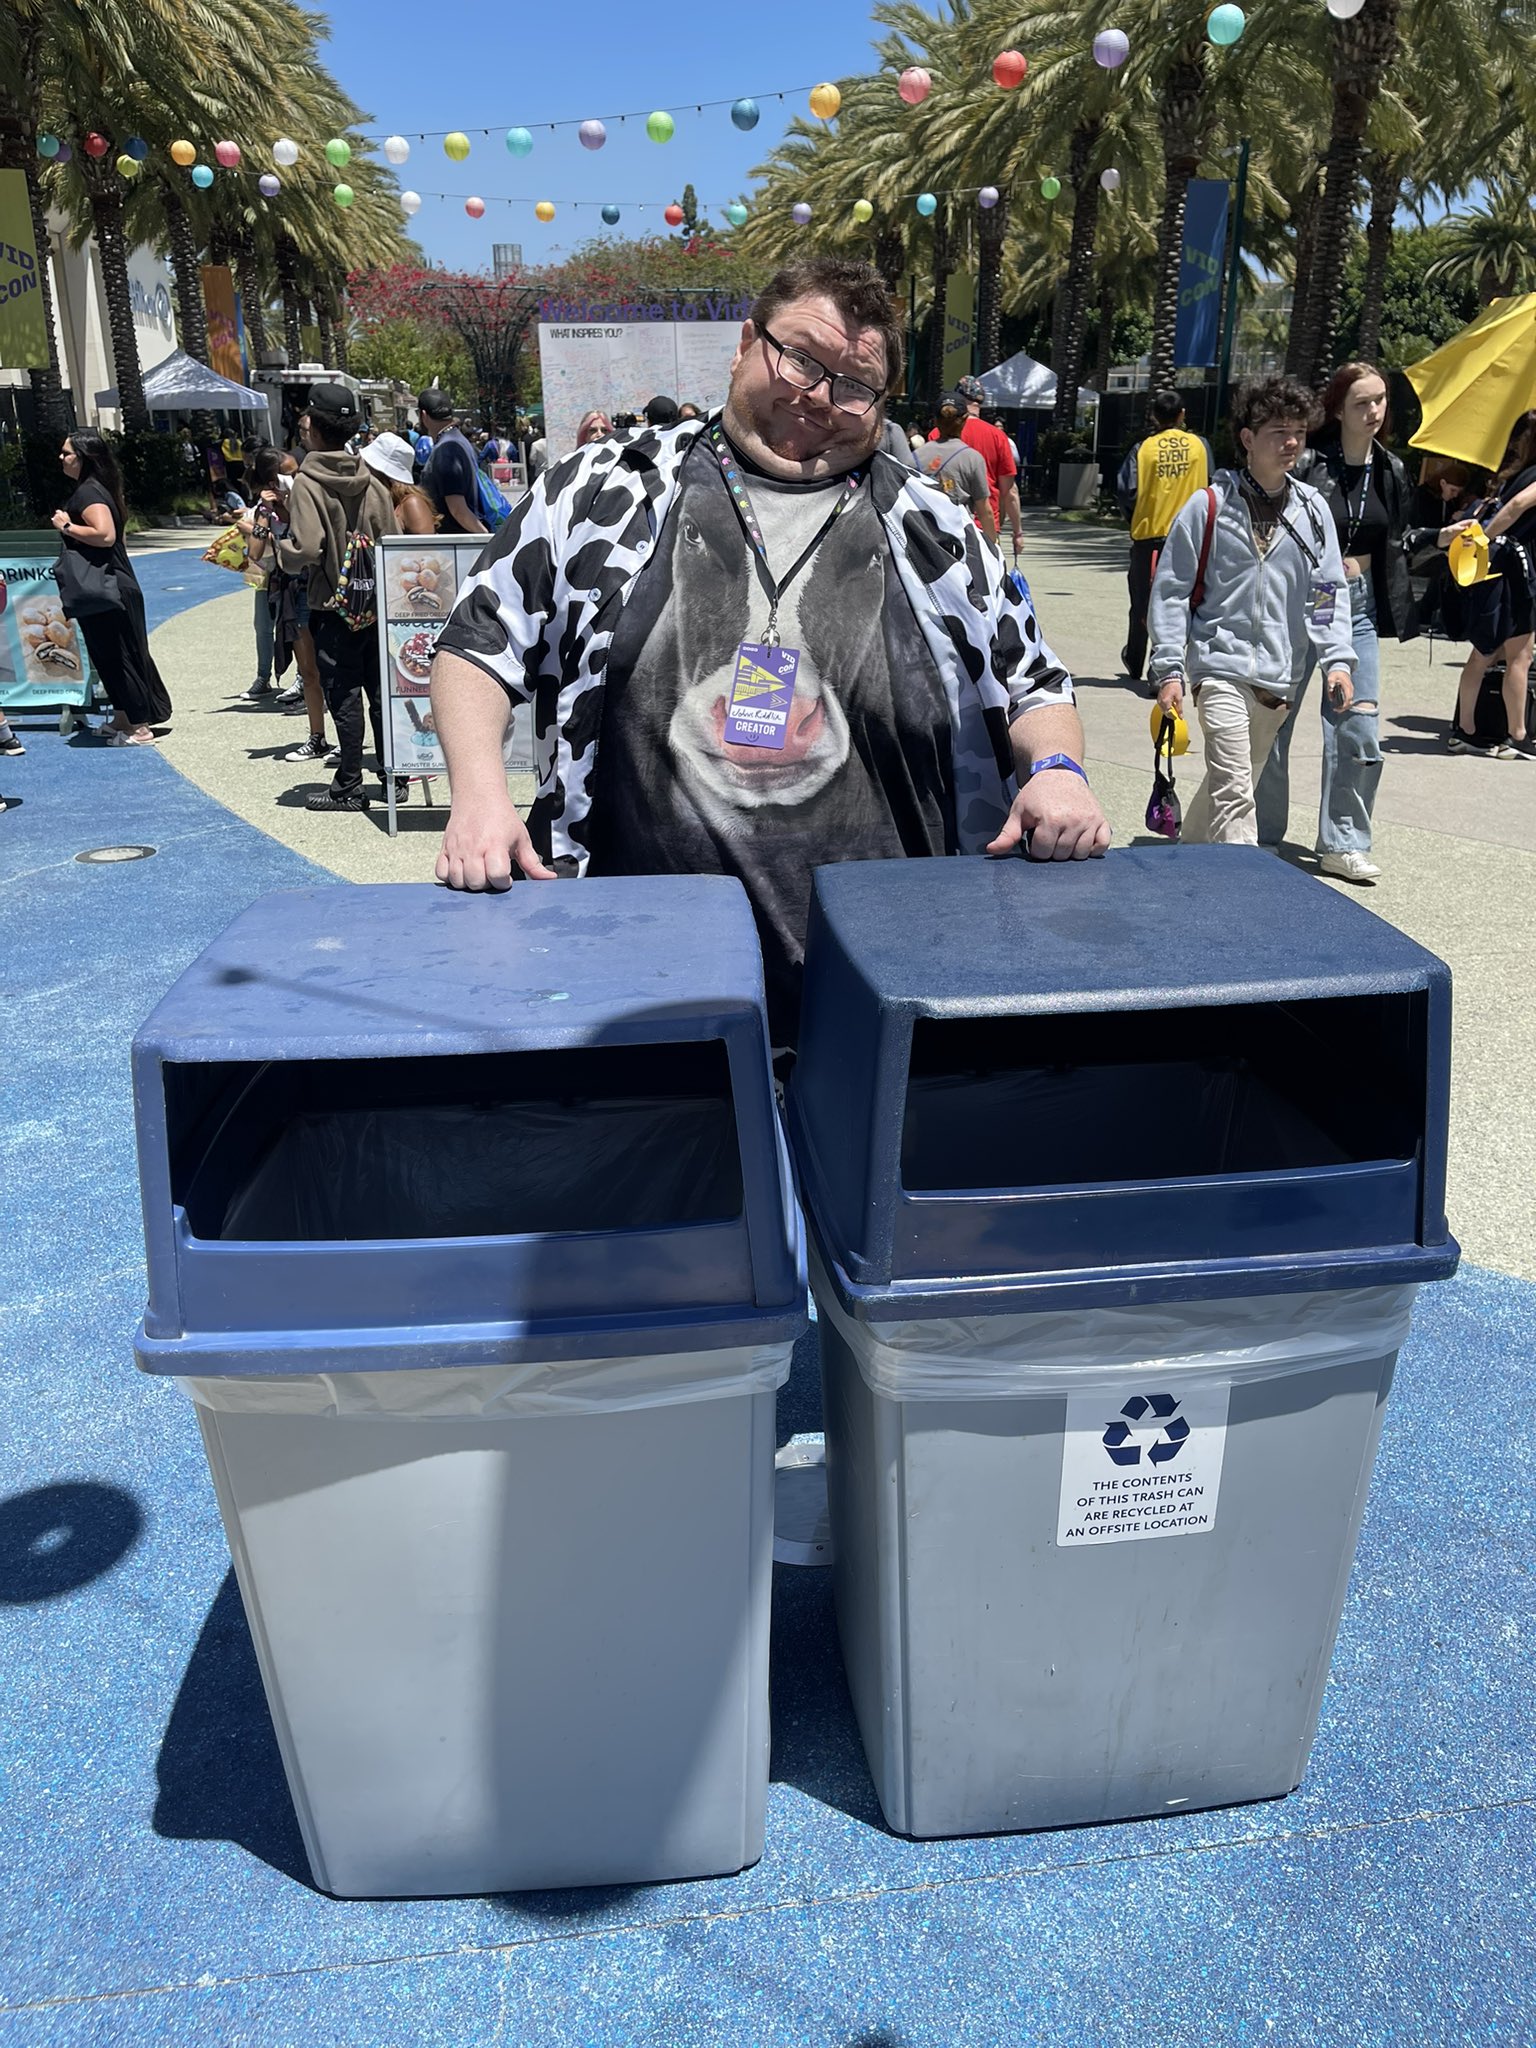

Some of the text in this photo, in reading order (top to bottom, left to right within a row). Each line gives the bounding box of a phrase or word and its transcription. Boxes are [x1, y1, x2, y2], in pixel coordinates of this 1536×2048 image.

[1185, 245, 1219, 276] VID
[1180, 275, 1218, 307] CON
[538, 296, 754, 321] Welcome to Vid
[550, 327, 623, 339] WHAT INSPIRES YOU?
[948, 314, 970, 333] VID
[945, 334, 970, 353] CON
[1158, 437, 1189, 449] CSC
[1158, 448, 1190, 463] EVENT
[1157, 462, 1190, 478] STAFF
[781, 650, 796, 664] VID
[778, 662, 795, 674] CON
[395, 686, 428, 694] FUNNEL
[735, 720, 776, 736] CREATOR
[1092, 1472, 1193, 1491] THE CONTENTS
[1076, 1486, 1204, 1507] OF THIS TRASH CAN
[1084, 1502, 1195, 1522] ARE RECYCLED AT
[1065, 1514, 1208, 1538] AN OFFSITE LOCATION
